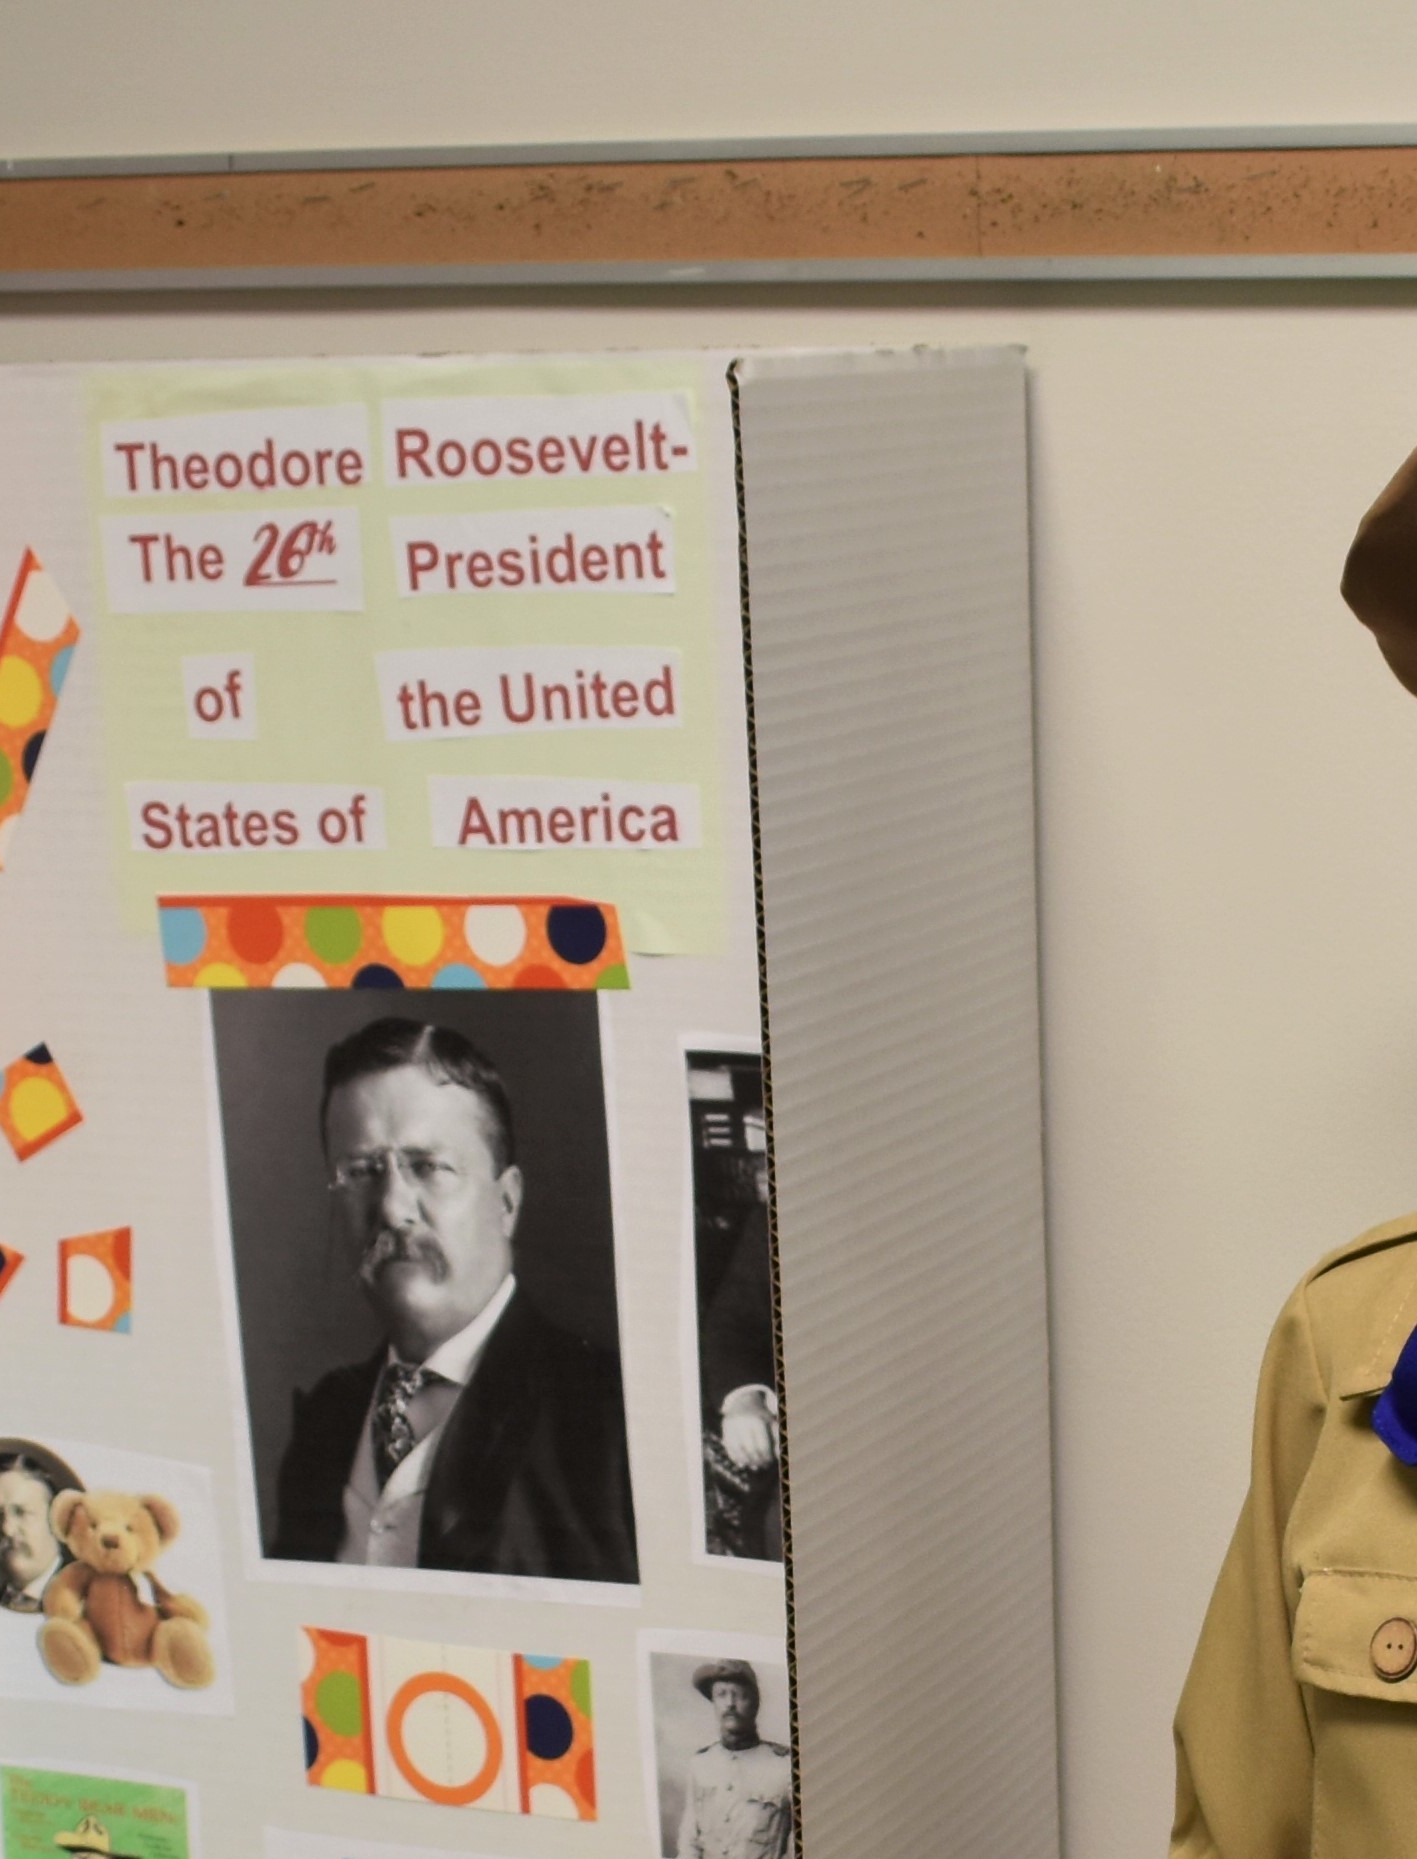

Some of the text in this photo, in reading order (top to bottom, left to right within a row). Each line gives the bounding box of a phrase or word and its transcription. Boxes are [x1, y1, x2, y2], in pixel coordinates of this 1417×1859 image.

[115, 419, 689, 492] Theodore Roosevelt-
[129, 519, 666, 592] The 26th President
[193, 665, 675, 731] of the United
[140, 792, 679, 850] States of America
